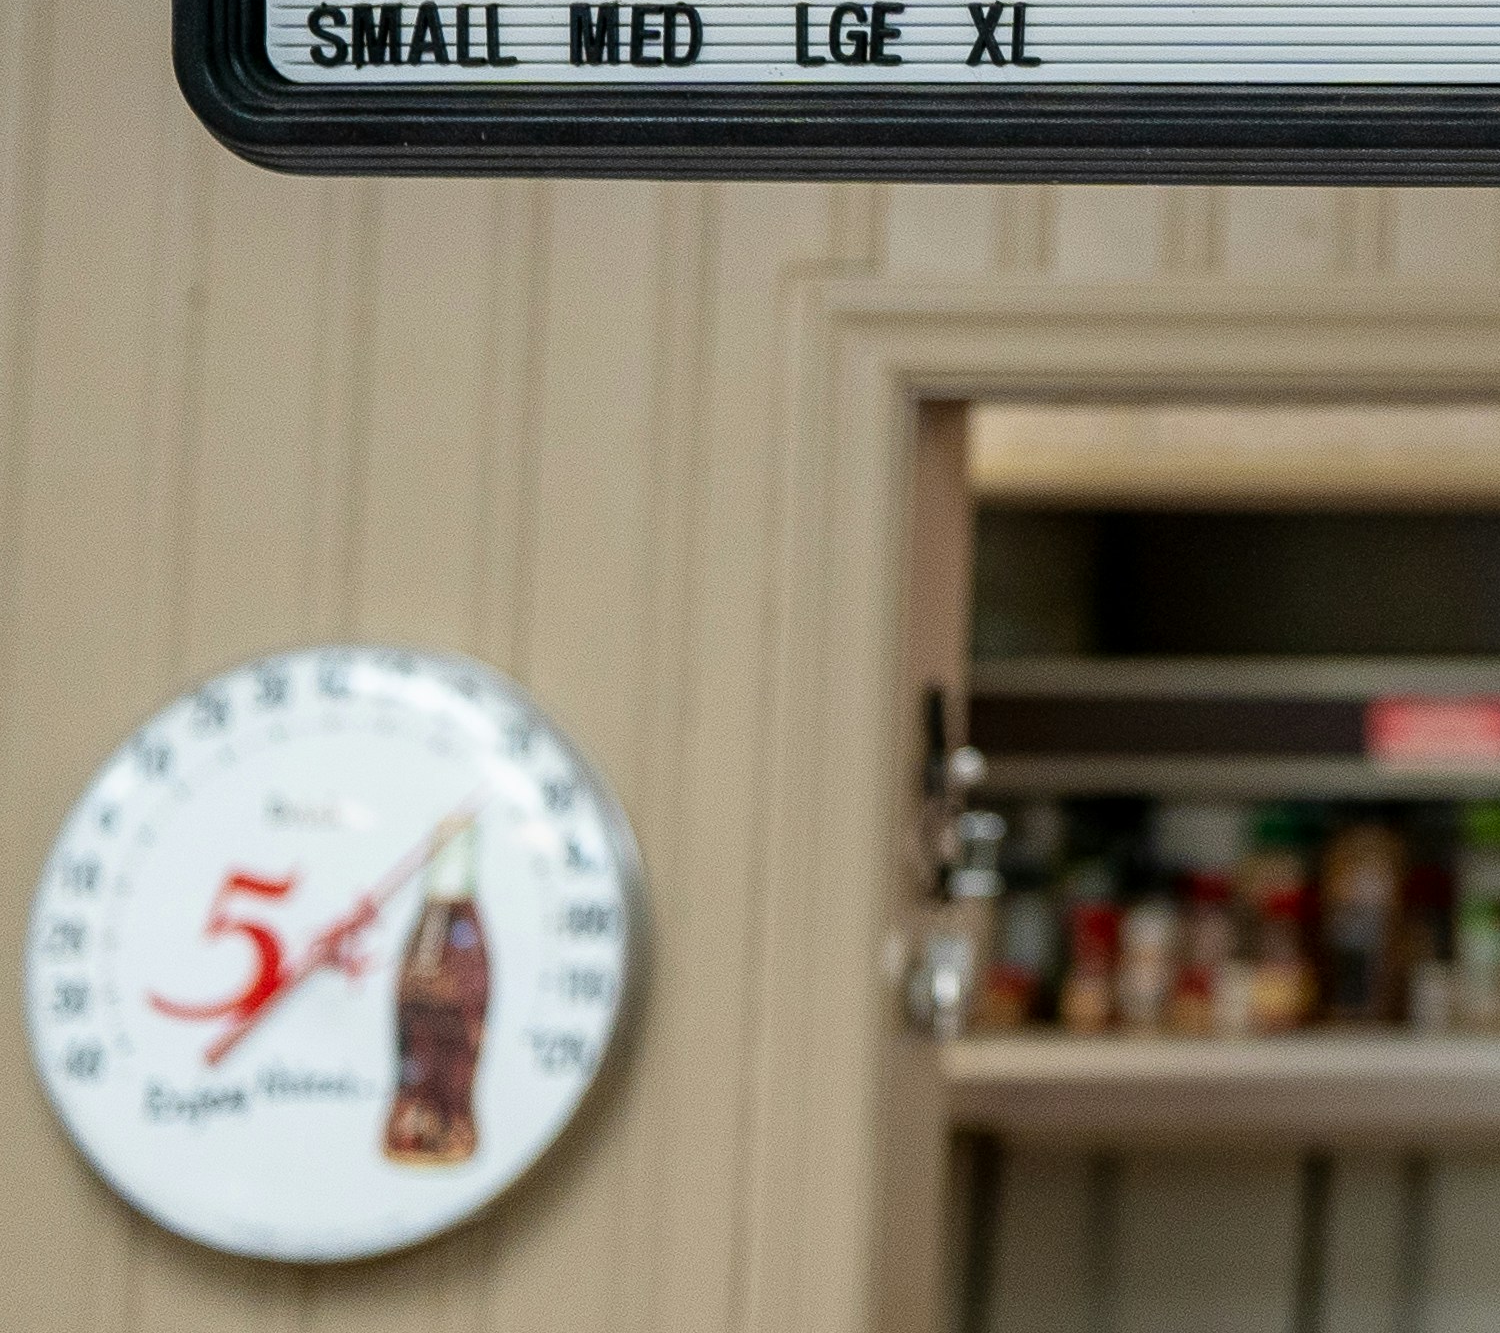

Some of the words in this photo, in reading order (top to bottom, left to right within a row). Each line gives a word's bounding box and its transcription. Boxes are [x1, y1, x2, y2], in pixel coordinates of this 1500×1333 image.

[309, 3, 518, 69] SMALL
[570, 3, 703, 67] MED
[796, 2, 903, 68] LGE
[966, 1, 1042, 68] XL
